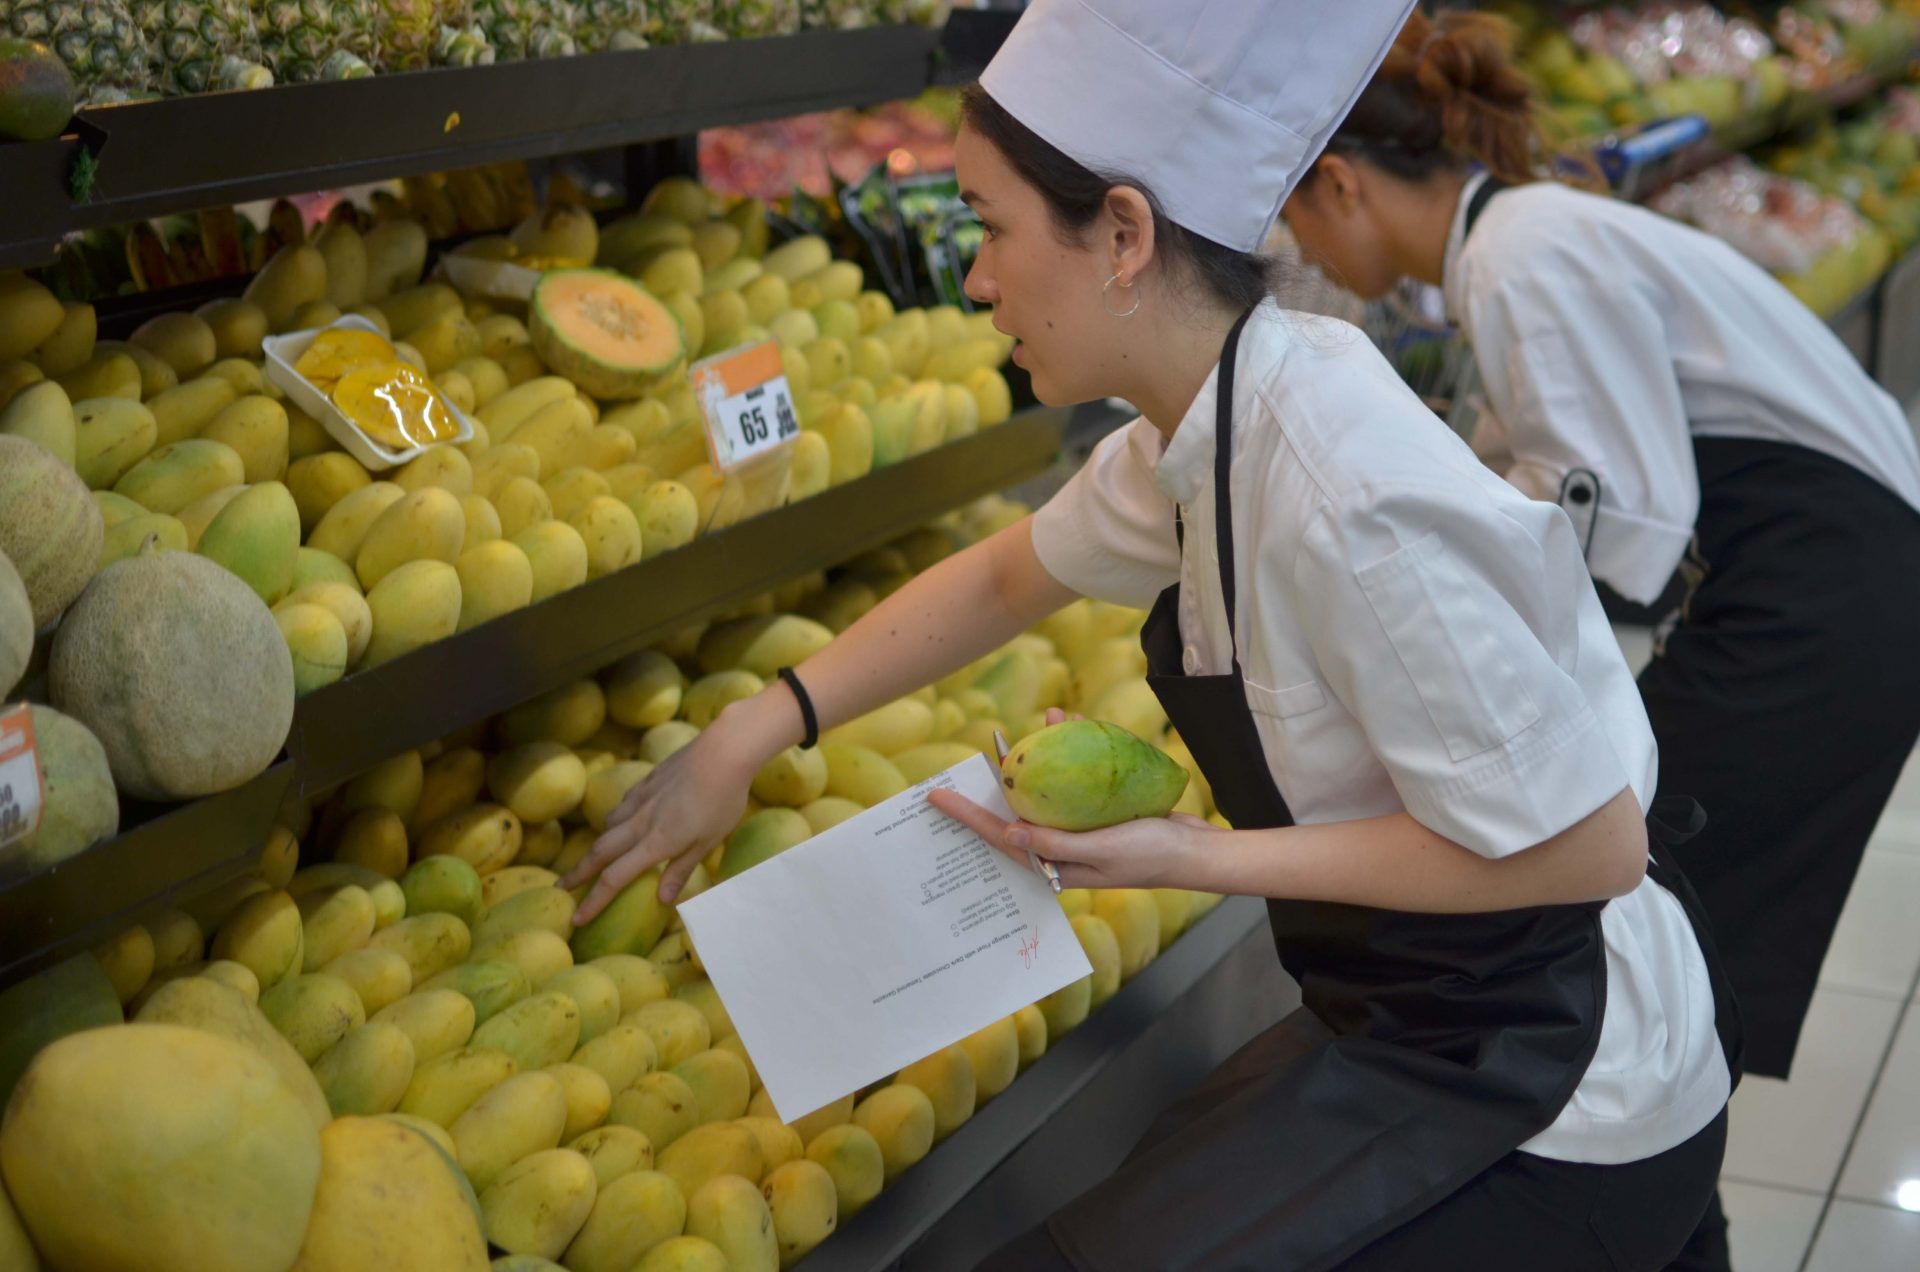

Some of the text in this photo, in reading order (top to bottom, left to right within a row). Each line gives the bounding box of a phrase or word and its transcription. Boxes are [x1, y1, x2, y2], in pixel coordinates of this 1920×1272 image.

[739, 404, 769, 446] 65
[892, 812, 918, 829] Tamarind
[874, 825, 892, 837] Sauce
[935, 861, 950, 872] water
[937, 880, 949, 889] milk
[983, 871, 1002, 885] Filling
[945, 882, 961, 894] green
[920, 889, 946, 906] mangoes
[977, 901, 999, 915] Toasted
[1005, 908, 1020, 920] Base
[1010, 924, 1028, 936] Green
[991, 932, 1011, 946] Mango
[950, 956, 964, 966] Dark
[964, 950, 976, 959] with
[922, 963, 951, 980] Chocolate
[896, 977, 922, 994] Tamarind
